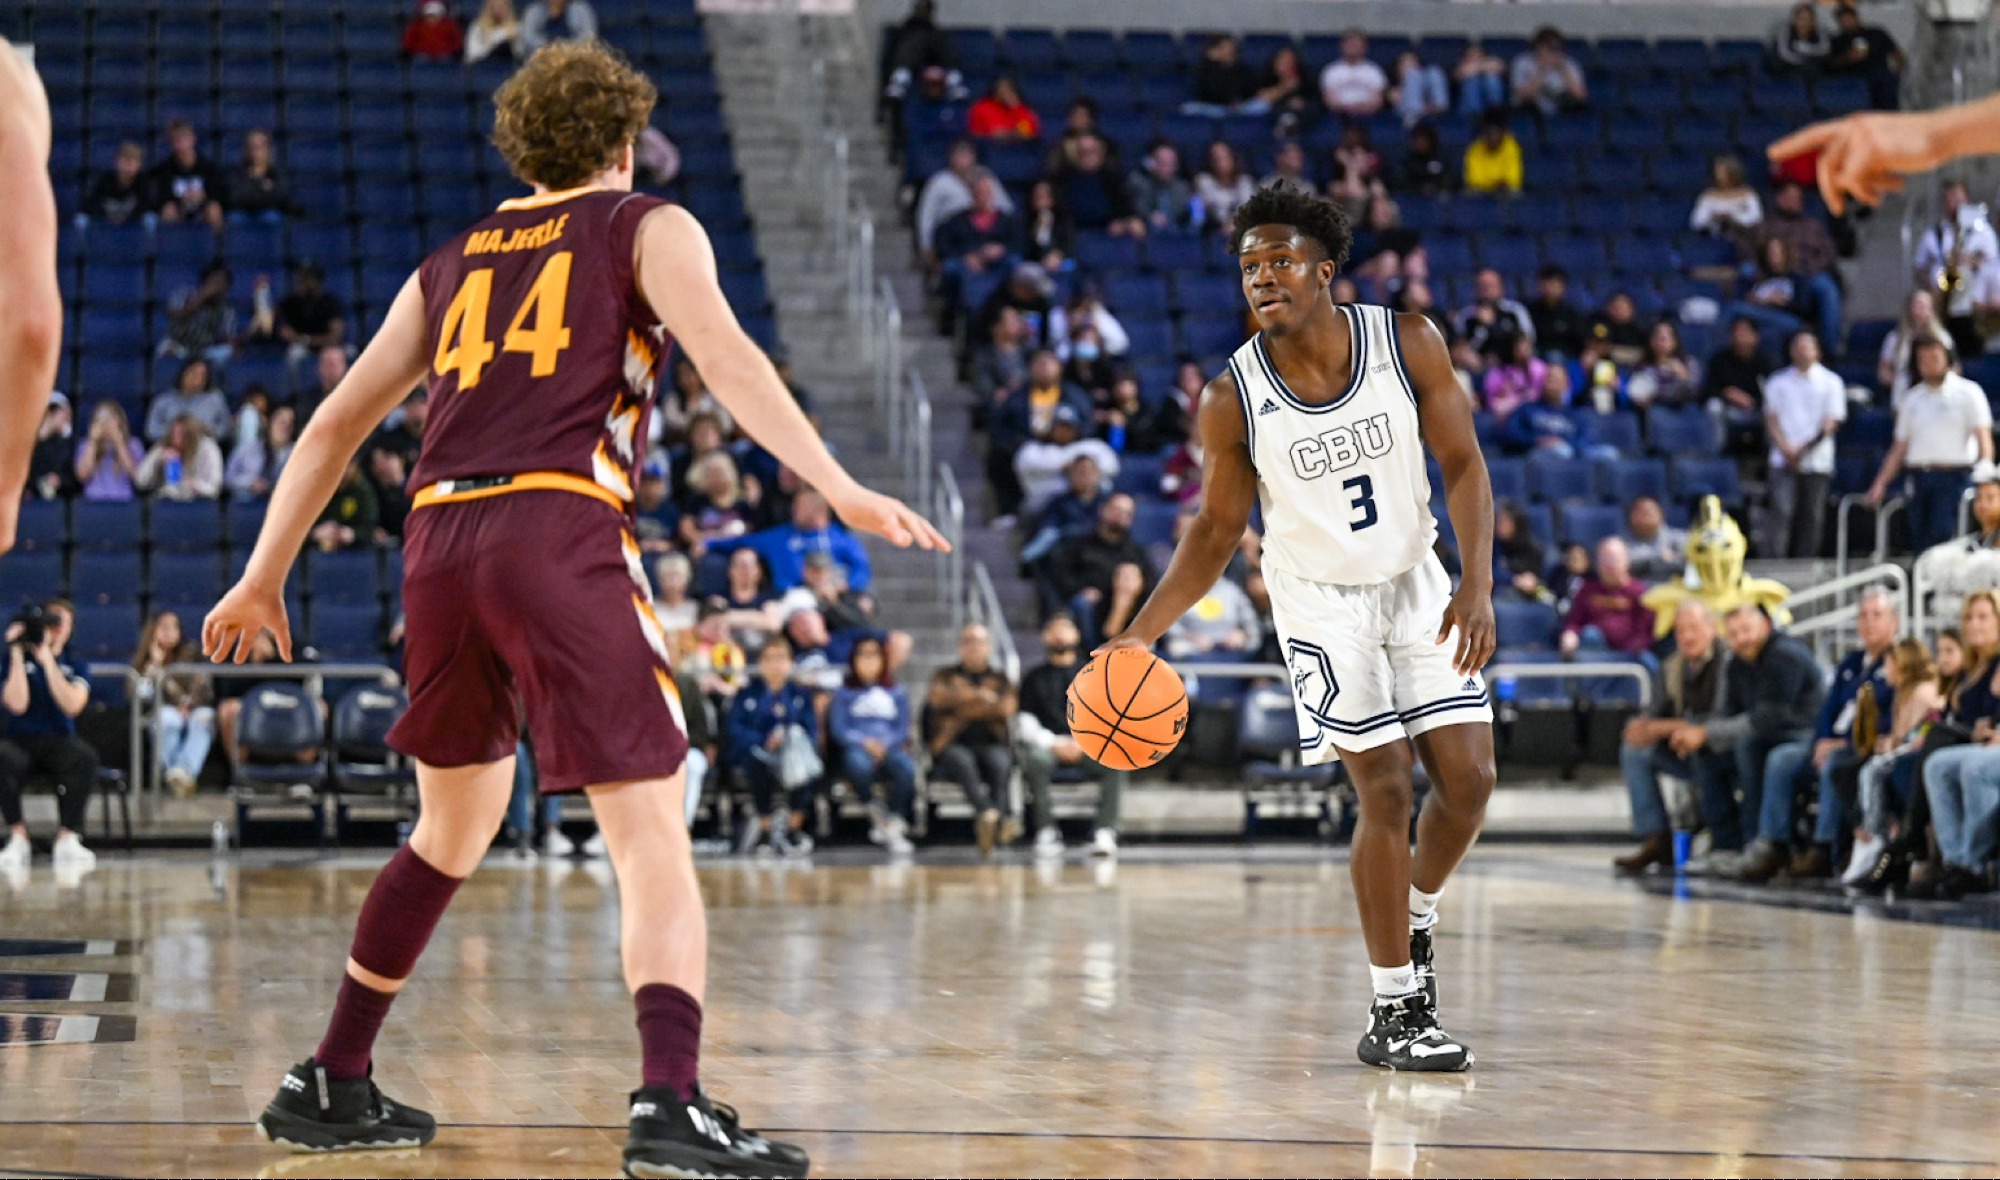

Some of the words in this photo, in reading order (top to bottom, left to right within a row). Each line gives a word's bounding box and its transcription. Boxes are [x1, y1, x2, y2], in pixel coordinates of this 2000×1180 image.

[464, 213, 569, 256] MAJERLE
[434, 251, 573, 392] 44
[1290, 412, 1393, 480] CBU
[1343, 474, 1378, 532] 3
